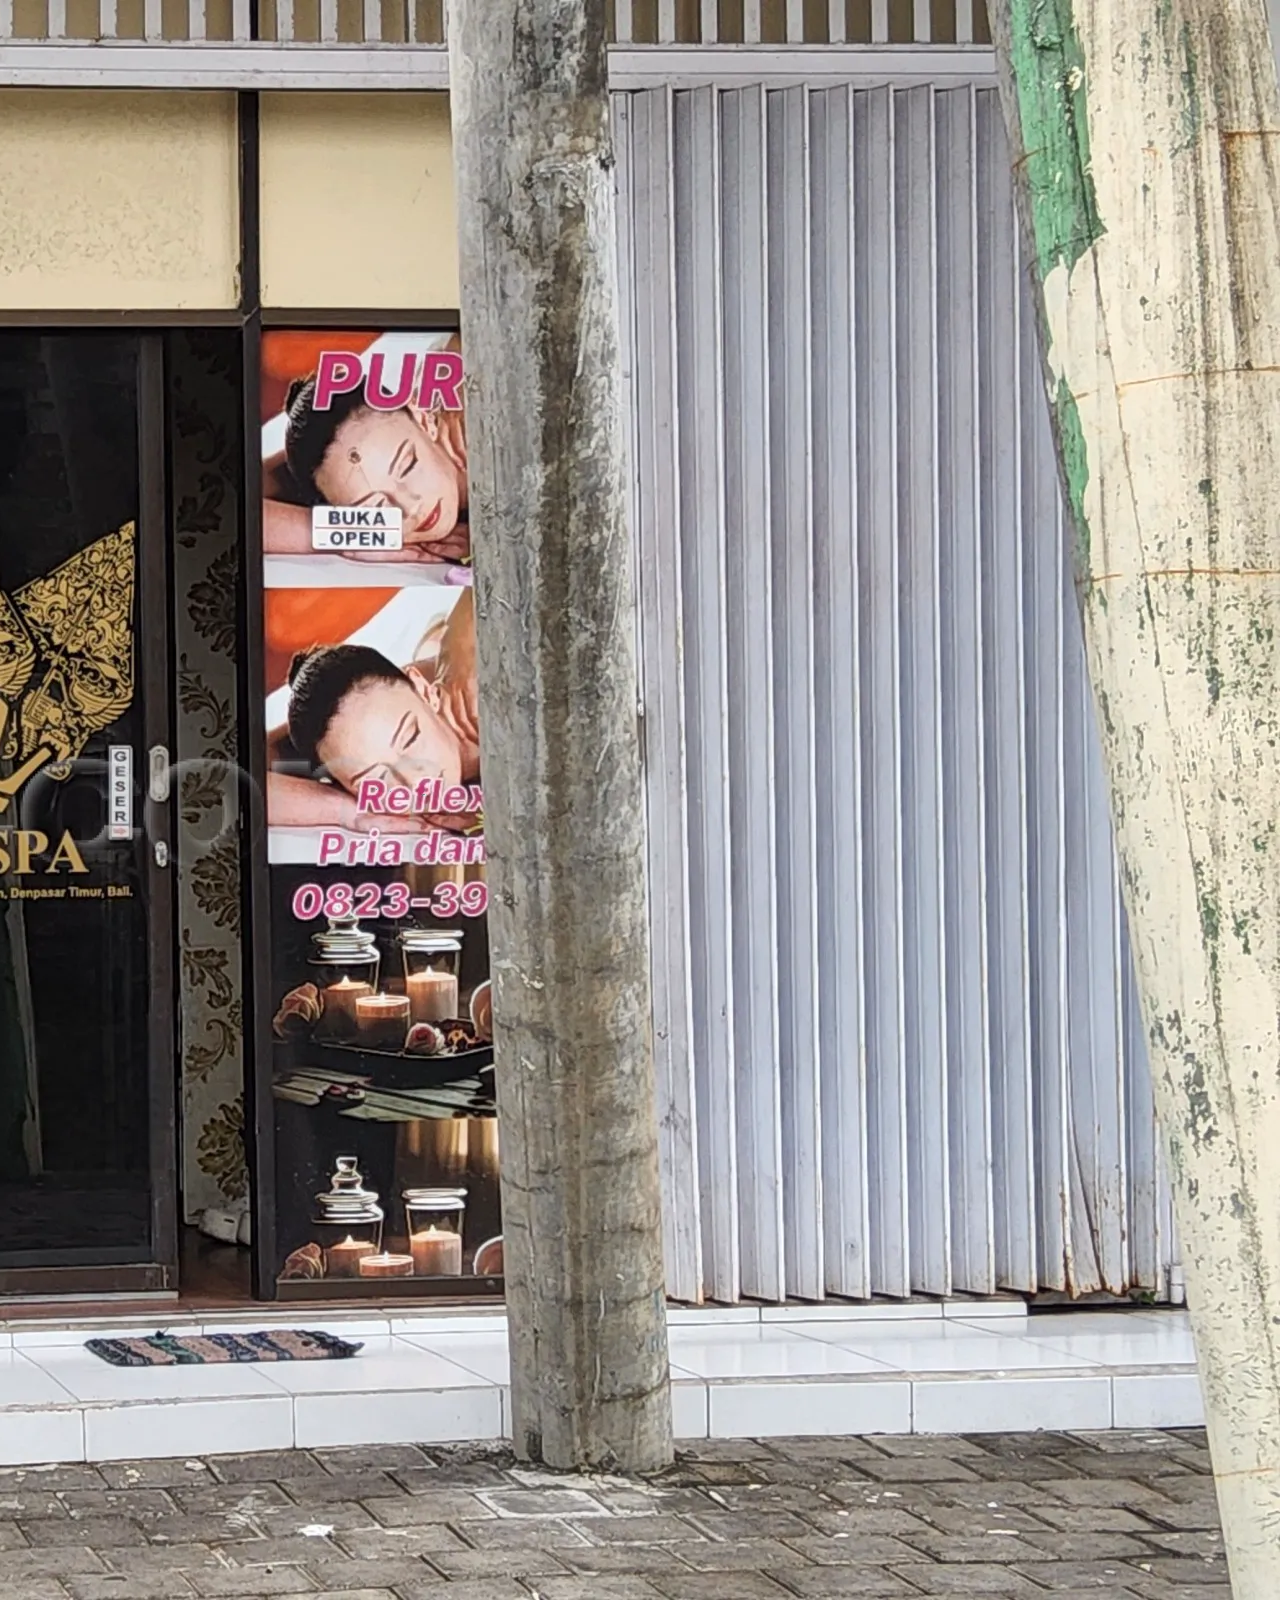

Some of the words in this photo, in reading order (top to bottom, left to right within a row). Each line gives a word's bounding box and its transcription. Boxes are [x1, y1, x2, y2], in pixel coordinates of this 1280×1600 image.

[328, 510, 386, 526] BUKA
[330, 531, 385, 546] OPEN
[114, 750, 127, 822] GESER
[317, 828, 402, 866] Pria
[413, 830, 486, 866] dan
[10, 887, 66, 900] Denpasar
[68, 886, 105, 898] Timur,
